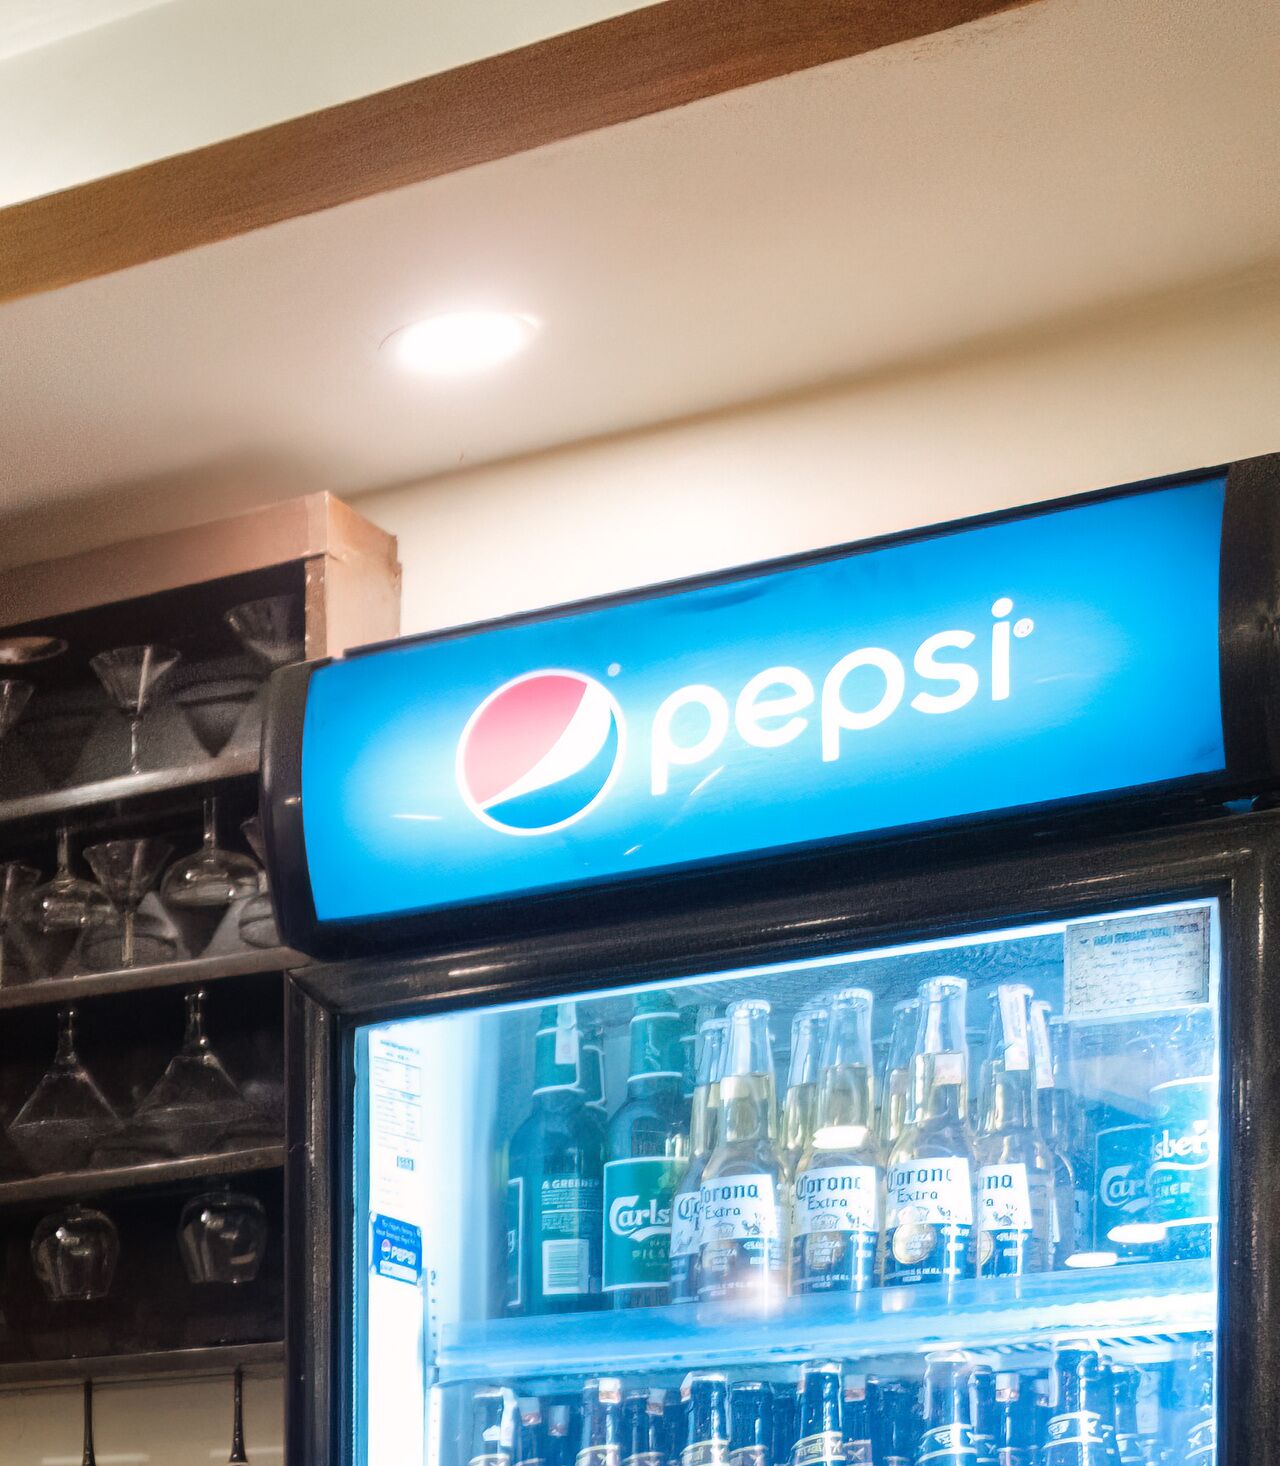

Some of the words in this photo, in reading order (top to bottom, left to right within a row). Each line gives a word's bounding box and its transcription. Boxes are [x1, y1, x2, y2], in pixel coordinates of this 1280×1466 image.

[650, 596, 1014, 796] pepsi
[807, 1195, 848, 1211] Extra
[897, 1187, 939, 1204] Extra
[609, 1195, 672, 1237] Carls
